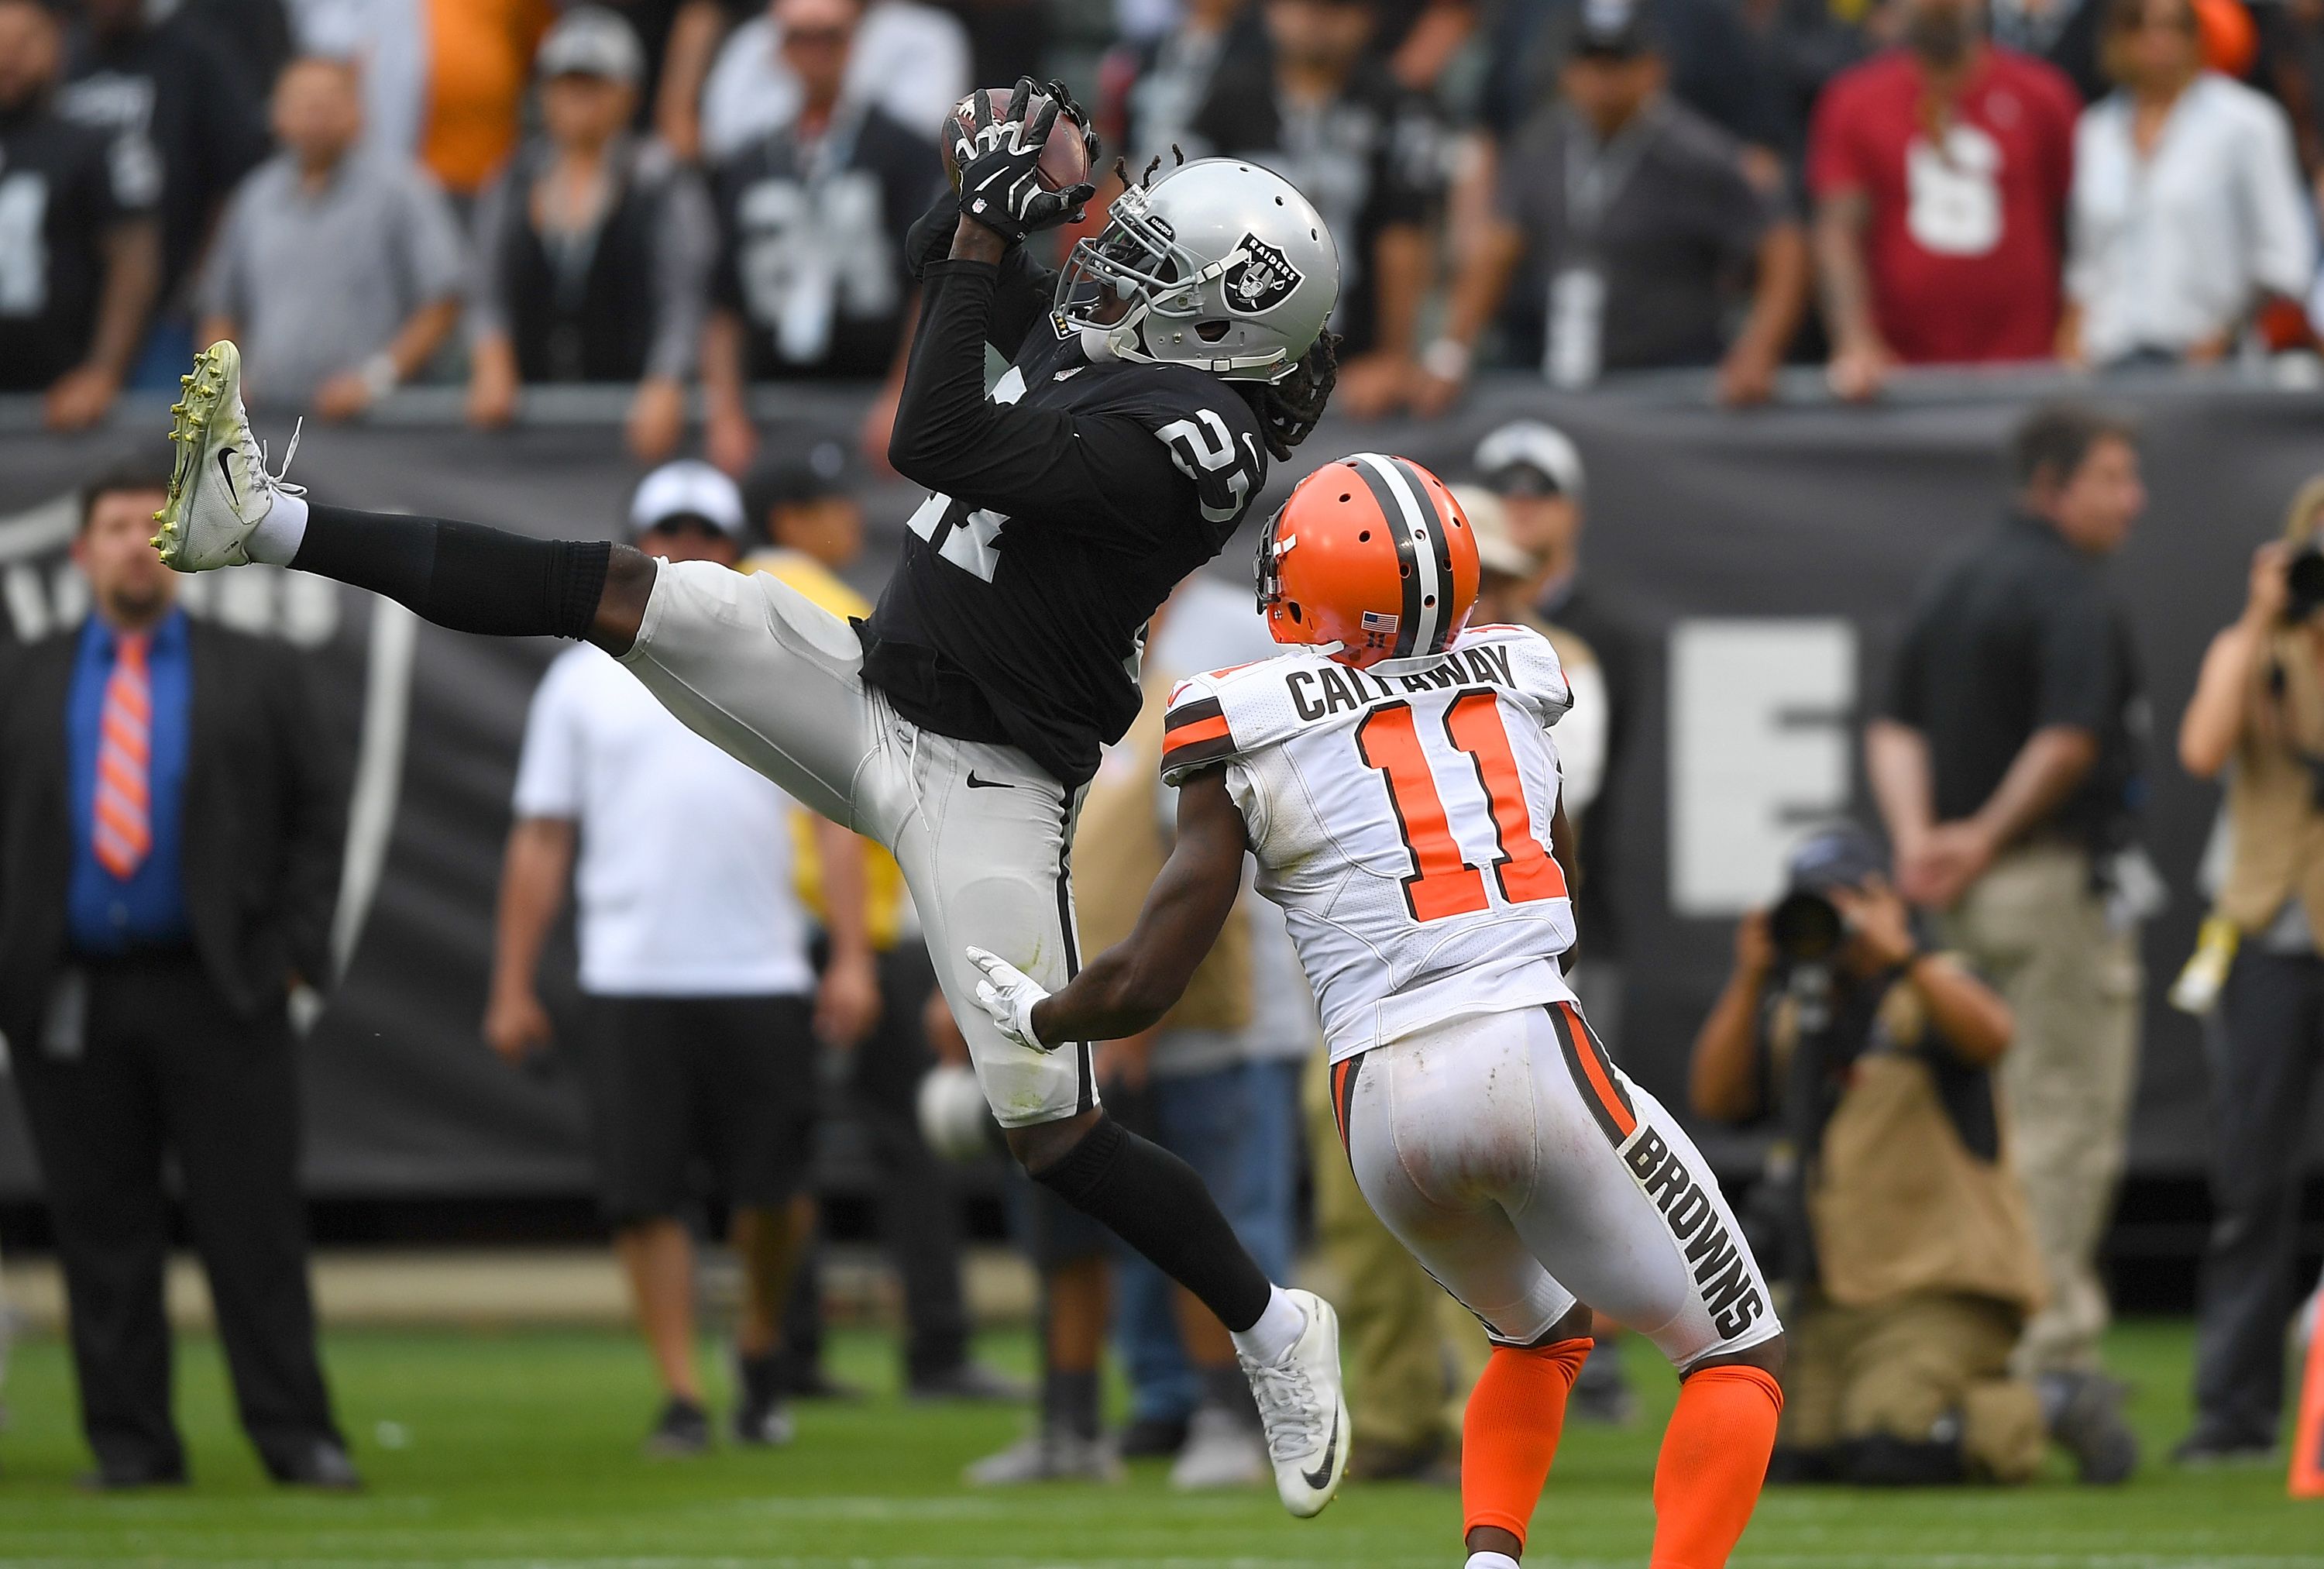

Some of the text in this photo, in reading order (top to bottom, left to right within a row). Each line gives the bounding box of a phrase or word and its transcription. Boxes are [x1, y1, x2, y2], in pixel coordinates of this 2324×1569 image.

[1150, 218, 1173, 236] RAIDERS
[1249, 238, 1296, 281] RAIDERS
[1153, 408, 1250, 523] 27
[1366, 631, 1386, 649] 11
[1355, 686, 1569, 924] 11
[1668, 620, 1855, 916] E
[1624, 1124, 1764, 1340] BROWNS
